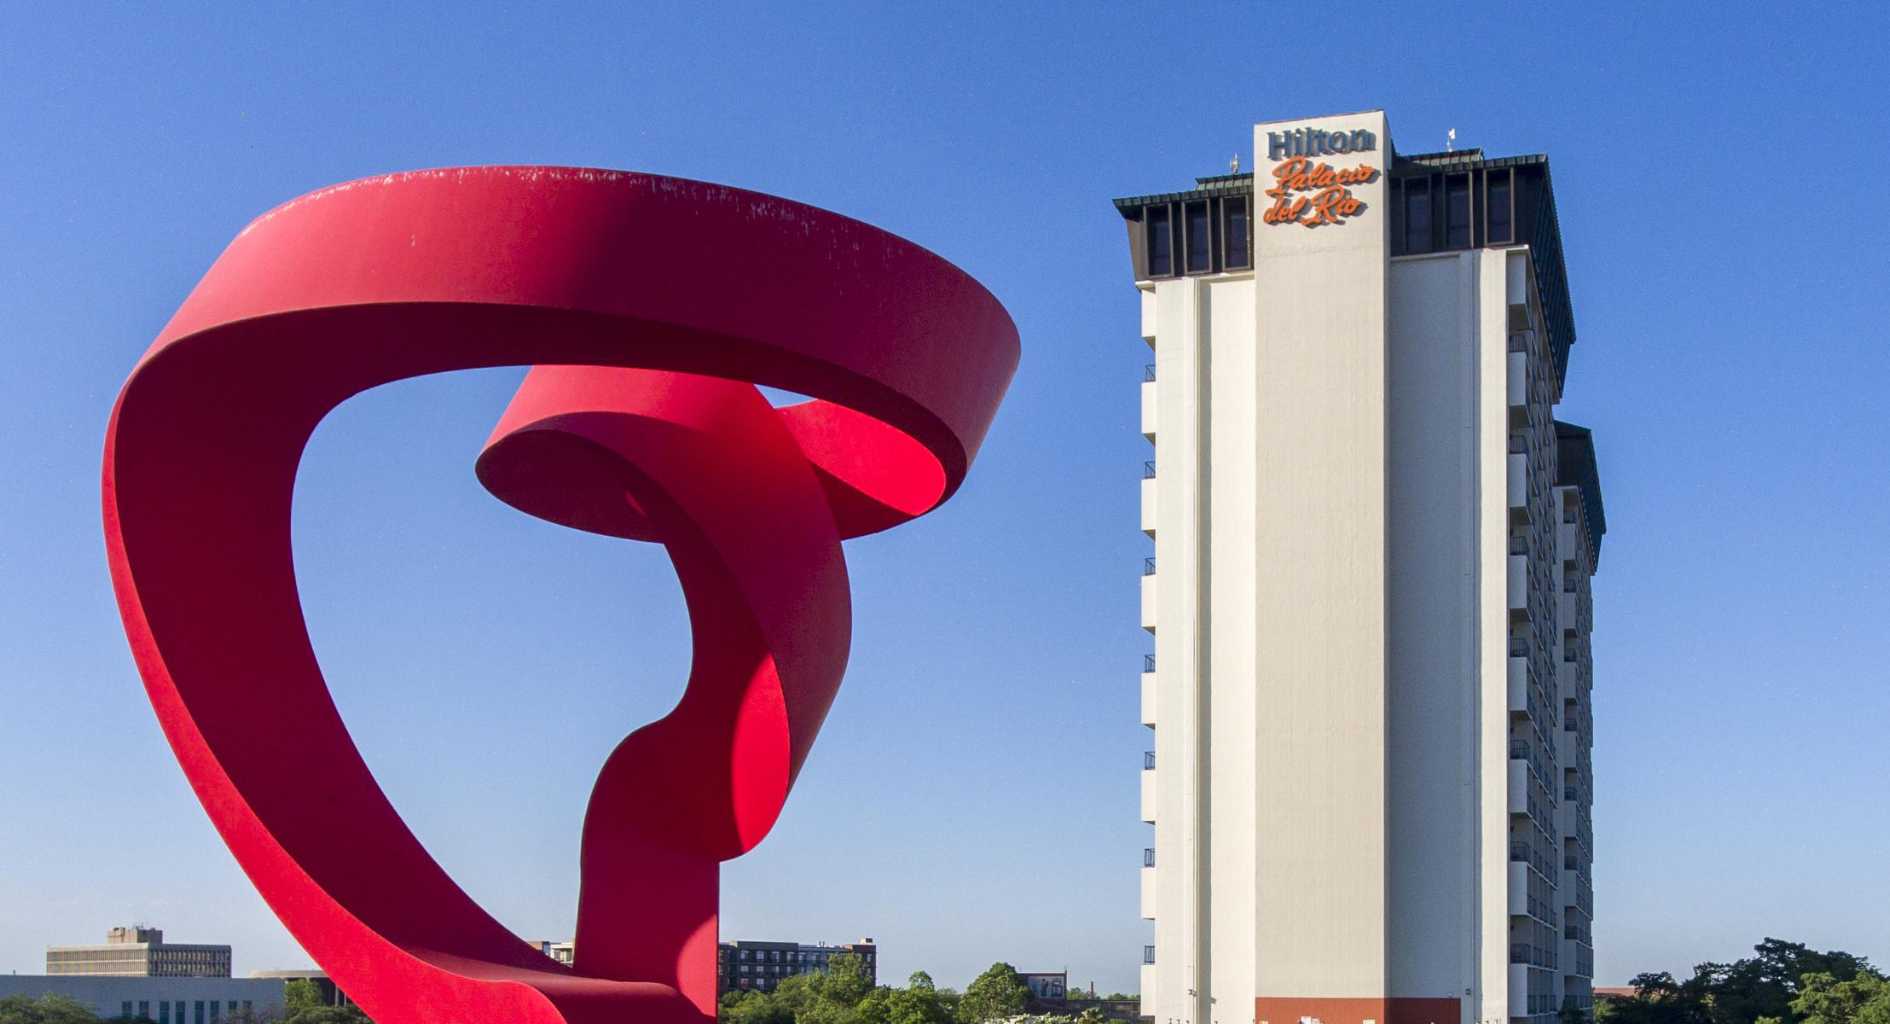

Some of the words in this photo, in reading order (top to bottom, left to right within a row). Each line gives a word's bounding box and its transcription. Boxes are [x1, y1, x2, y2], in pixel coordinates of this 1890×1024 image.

[1267, 127, 1376, 160] Hilton
[1271, 154, 1377, 191] Palacio
[1263, 189, 1307, 224] del
[1305, 185, 1361, 226] Rio
